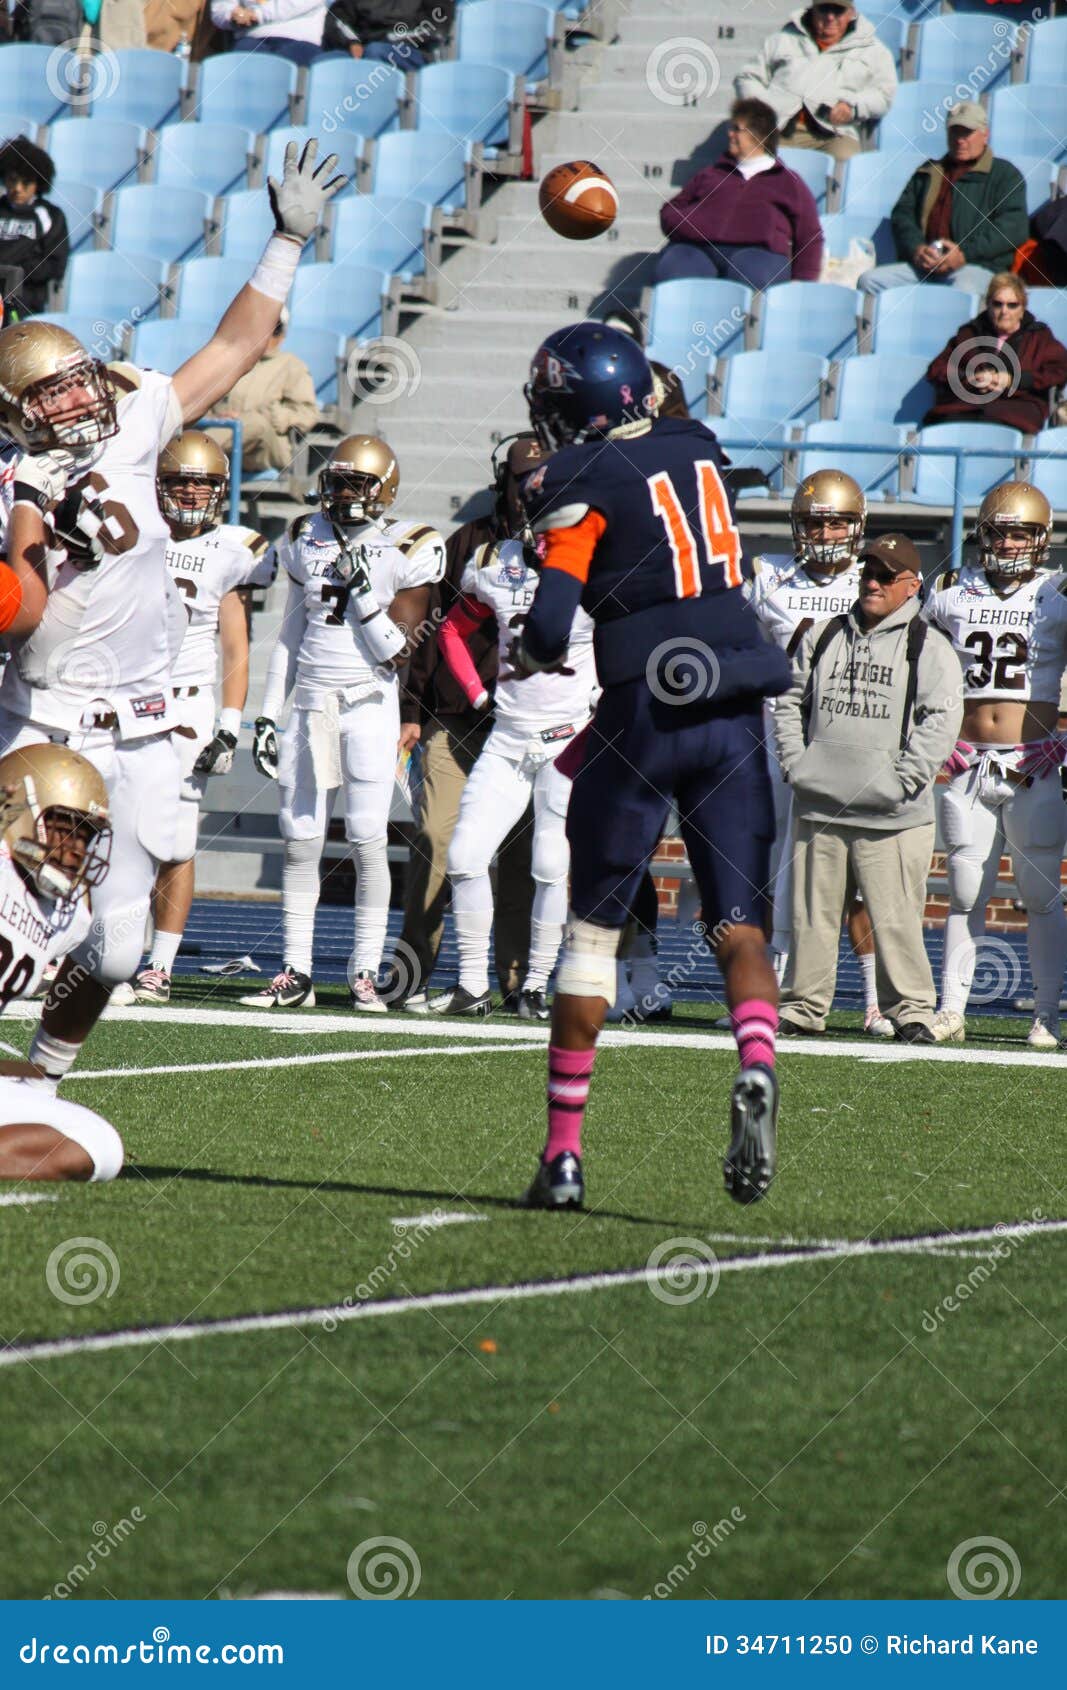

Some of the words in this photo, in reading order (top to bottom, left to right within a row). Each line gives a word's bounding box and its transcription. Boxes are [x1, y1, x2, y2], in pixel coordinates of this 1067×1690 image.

[717, 25, 735, 39] 12
[547, 355, 564, 388] B
[646, 459, 744, 599] 14
[165, 551, 206, 573] HIGH
[321, 584, 351, 626] 7
[787, 596, 852, 613] LEHIGH
[967, 608, 1032, 627] LEHIGH
[964, 630, 1029, 690] 32
[819, 696, 891, 719] FOOTBALL
[0, 893, 50, 952] LEHIGH
